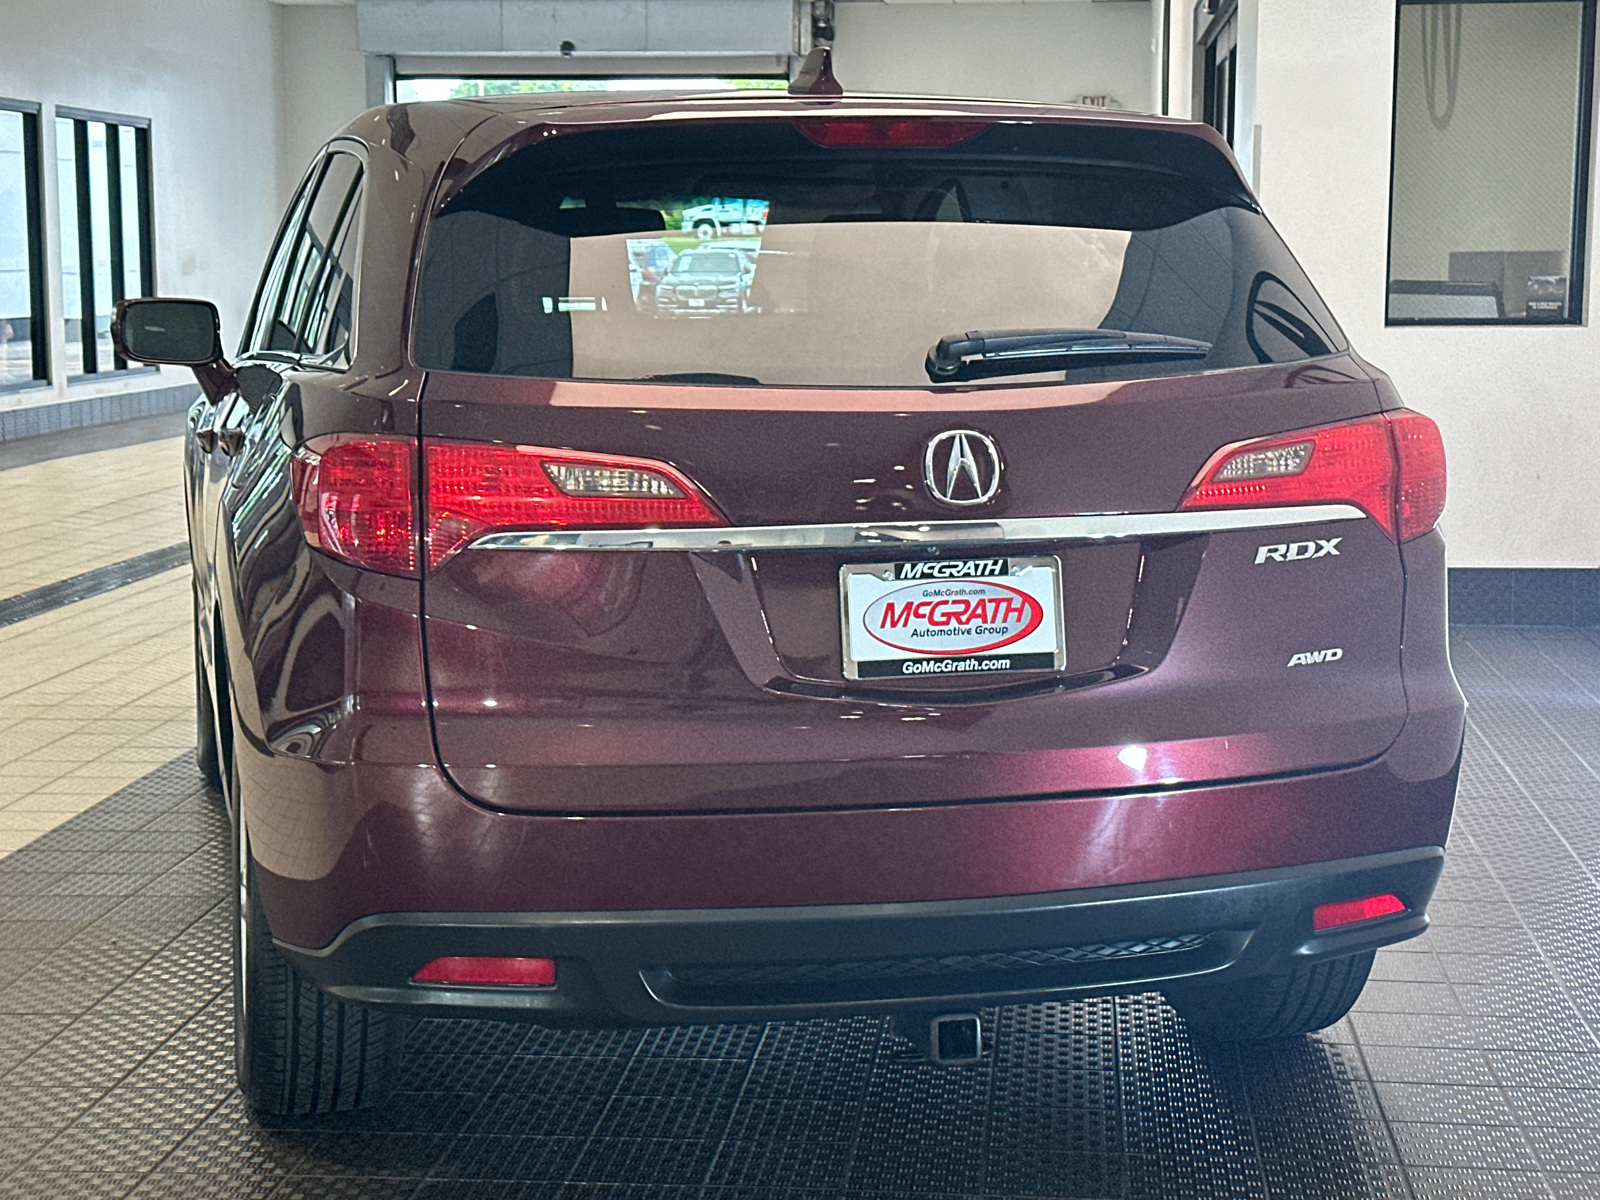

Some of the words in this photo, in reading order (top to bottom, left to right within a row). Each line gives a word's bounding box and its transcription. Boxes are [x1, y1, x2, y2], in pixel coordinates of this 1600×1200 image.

[1254, 537, 1343, 565] RDX
[922, 588, 985, 597] GoMcGrath.com
[911, 627, 972, 638] Automotive
[975, 625, 1009, 637] Group
[902, 658, 1011, 674] GoMcGrath.com
[1286, 648, 1343, 668] AWD
